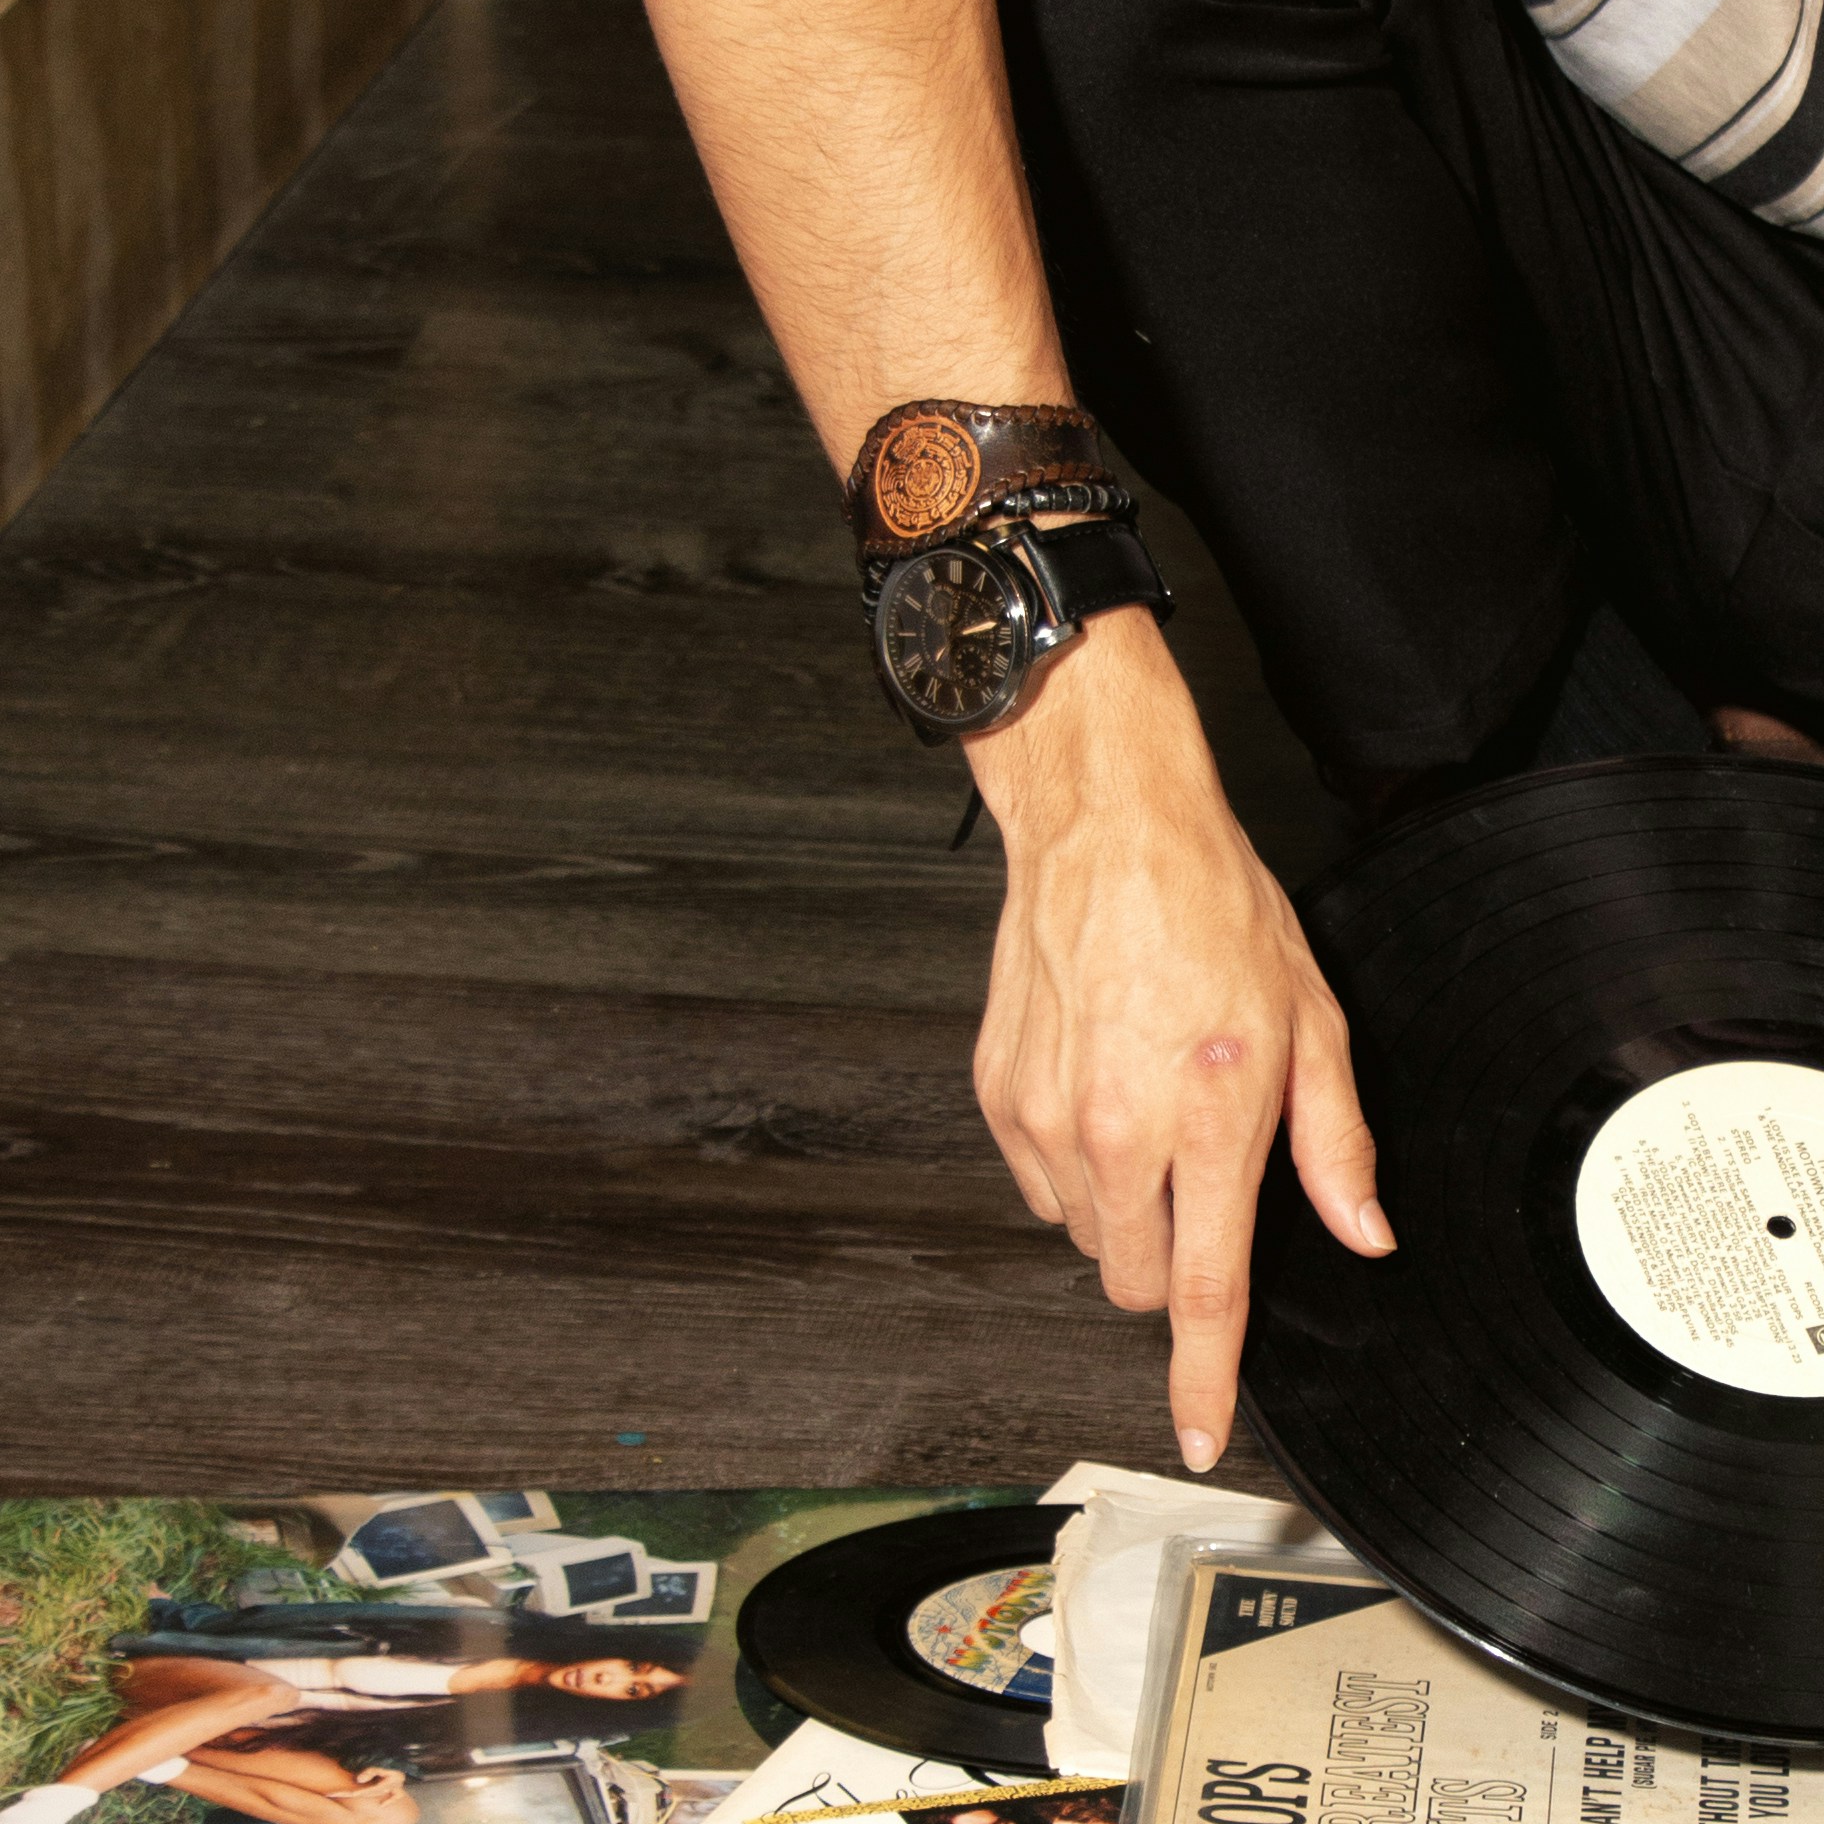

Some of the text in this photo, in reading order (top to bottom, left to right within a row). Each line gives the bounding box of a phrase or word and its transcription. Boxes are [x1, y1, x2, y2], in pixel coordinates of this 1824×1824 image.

[1742, 1130, 1757, 1150] SIDE
[1769, 1119, 1786, 1143] LOVE
[1729, 1128, 1752, 1164] STEREO
[1780, 1145, 1791, 1154] IS
[1761, 1124, 1775, 1142] THE
[1769, 1144, 1800, 1199] VANDELLAS
[1785, 1156, 1801, 1178] LIKE
[1799, 1189, 1816, 1213] HEAT
[1730, 1168, 1744, 1185] THE
[1739, 1188, 1756, 1213] SAME
[1760, 1236, 1777, 1261] SONG
[1774, 1268, 1792, 1294] FOUR
[1786, 1297, 1803, 1320] TOPS
[1238, 1599, 1256, 1617] THE
[1279, 1596, 1298, 1626] SOUND
[1540, 1721, 1558, 1740] SIDE
[1583, 1737, 1625, 1780] HELP
[1631, 1756, 1657, 1789] (SUGAR
[1749, 1784, 1789, 1818] YOU
